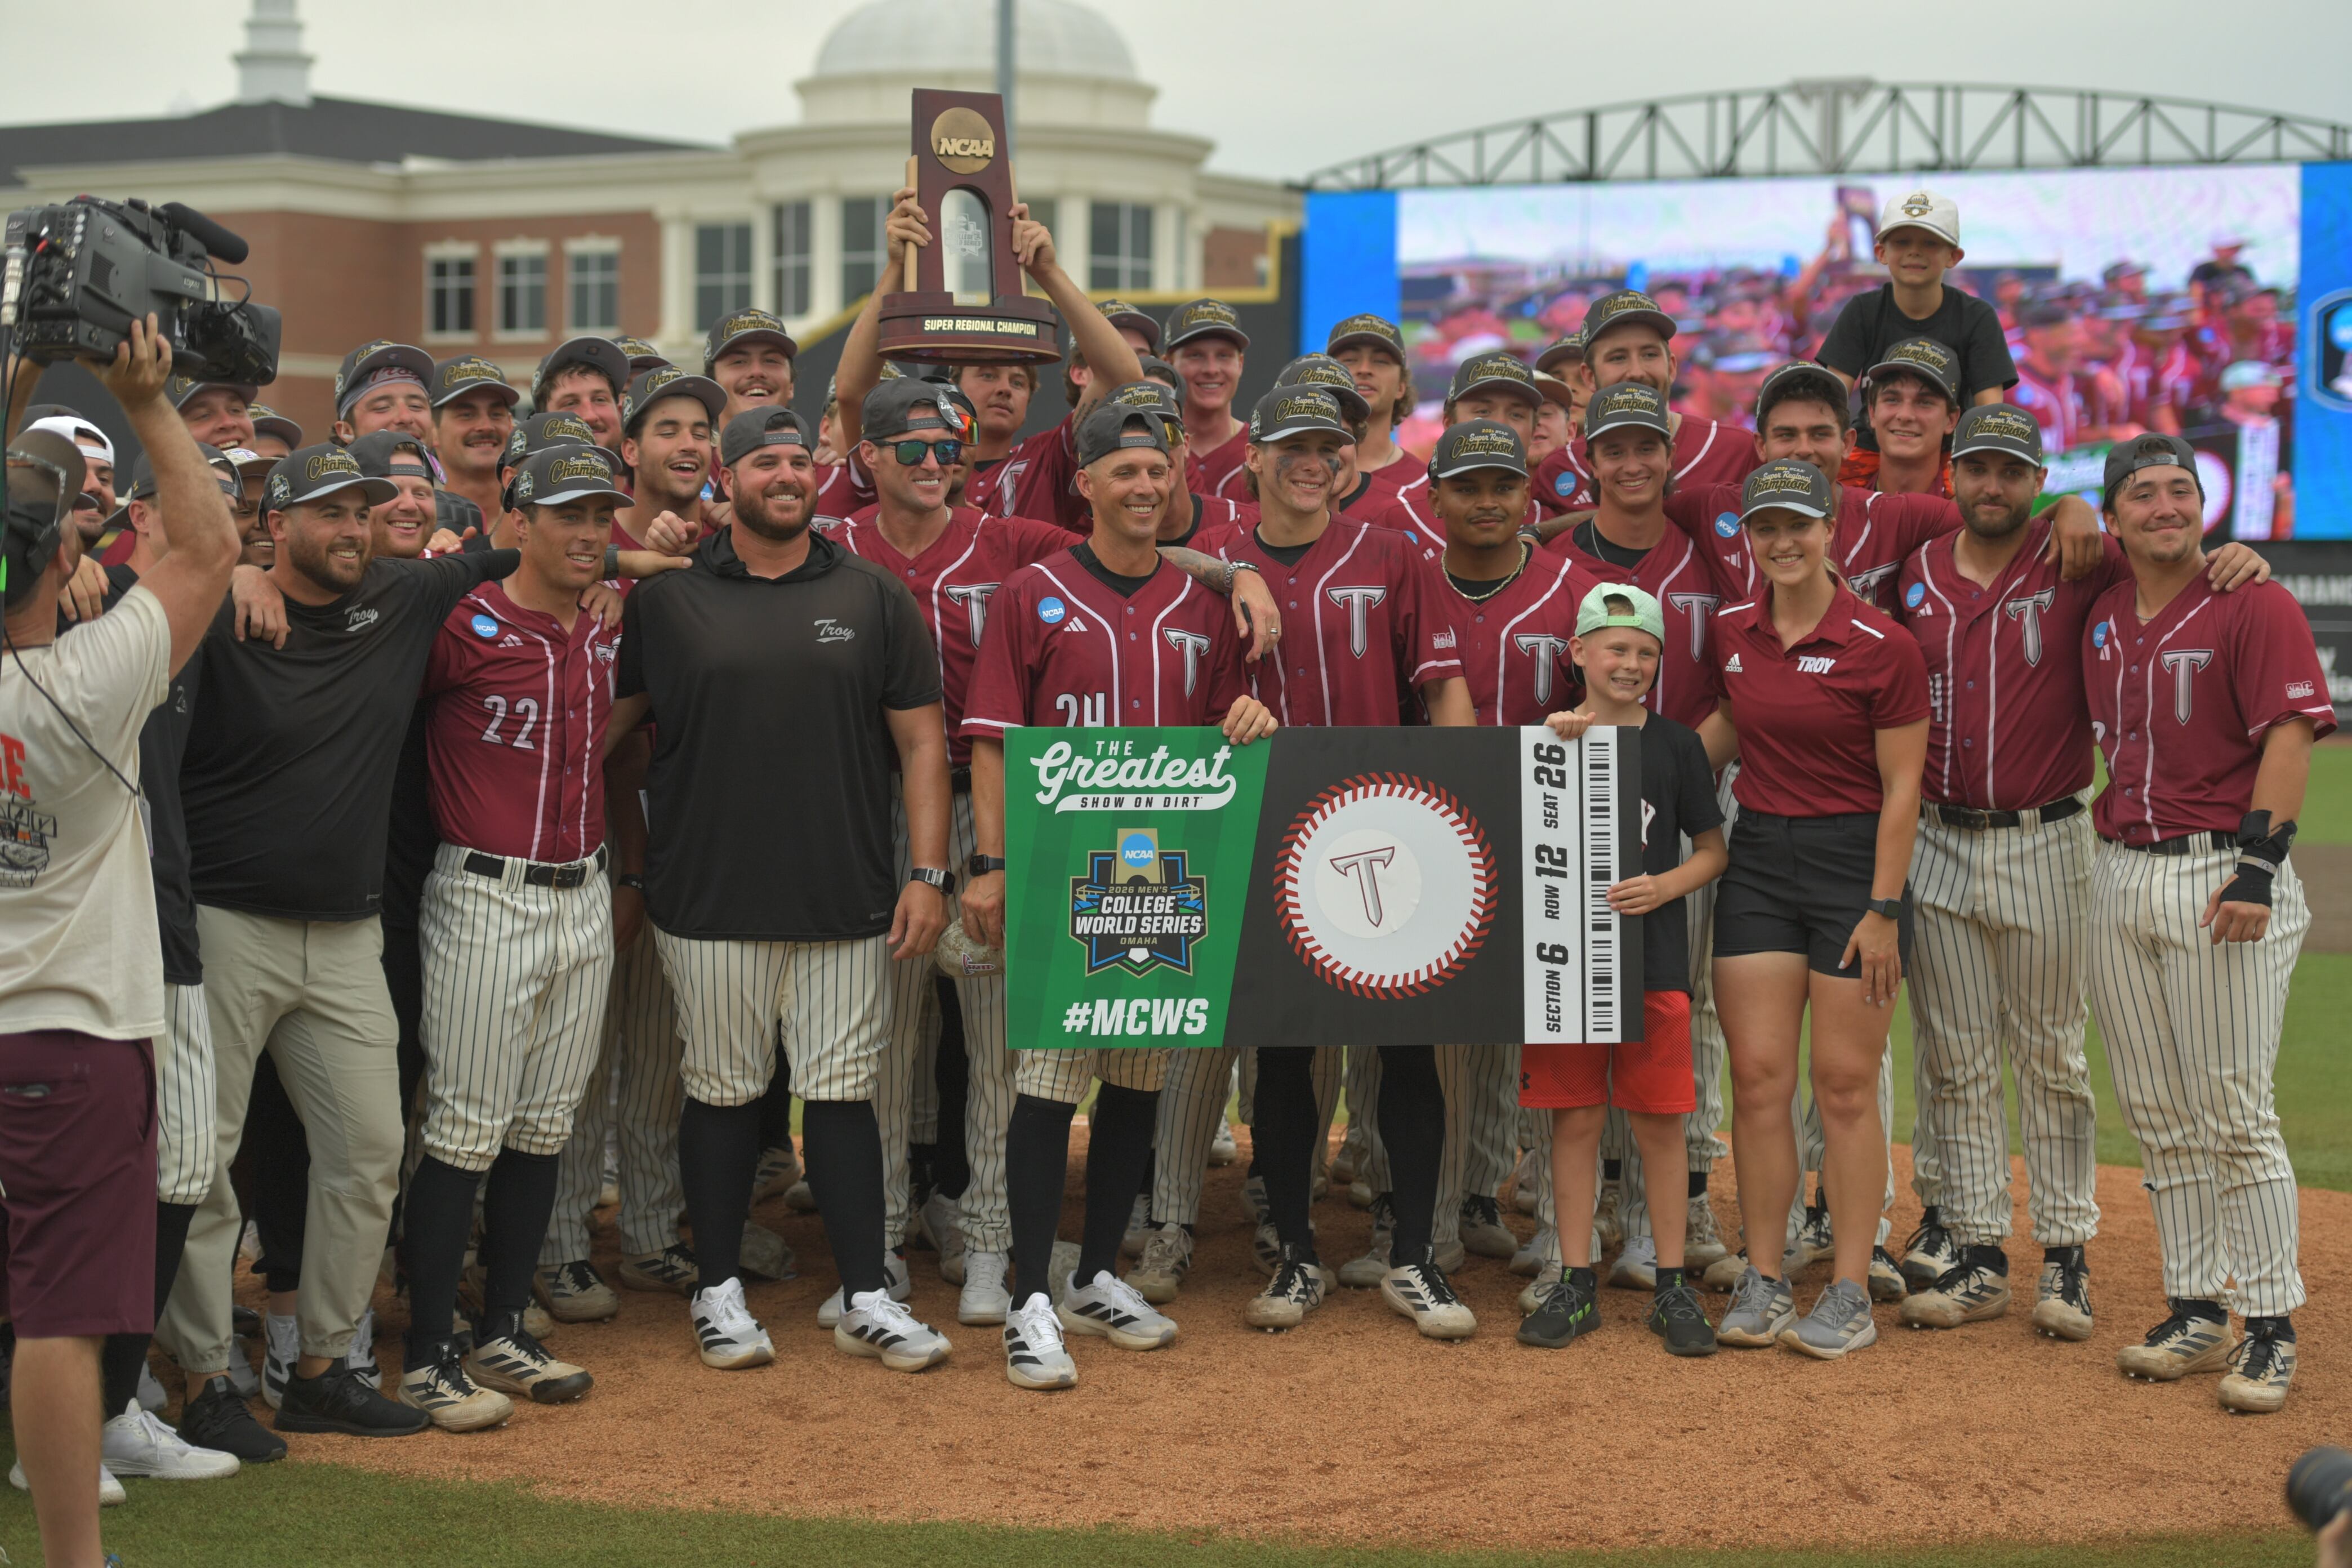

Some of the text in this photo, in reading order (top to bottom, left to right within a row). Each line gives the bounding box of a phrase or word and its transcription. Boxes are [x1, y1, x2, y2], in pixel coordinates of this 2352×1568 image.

[938, 138, 994, 158] NCAA
[924, 319, 1036, 336] SUPER REGIONAL CHAMPION
[1905, 343, 1924, 352] Super
[1316, 367, 1334, 375] Super
[1486, 359, 1505, 368] Super
[1119, 394, 1161, 407] mpions
[1295, 396, 1315, 404] Super
[1614, 393, 1658, 405] Super Regional
[1965, 416, 2032, 441] Champions
[1985, 415, 2032, 430] Super Regional
[1450, 435, 1514, 460] Champions
[1469, 433, 1514, 445] Super Regional
[570, 457, 590, 465] Super
[1763, 471, 1812, 483] Super Regional
[1747, 476, 1812, 502] Champions
[1717, 519, 1735, 536] NCAA
[344, 603, 378, 625] Troy
[1042, 607, 1063, 618] NCAA
[814, 619, 855, 642] Troy
[1326, 586, 1387, 659] T
[1668, 593, 1720, 662] T
[2006, 586, 2055, 667] T
[1162, 627, 1211, 702] T
[1514, 634, 1569, 706] T
[1797, 656, 1836, 674] TROY
[2161, 649, 2214, 726] T
[2286, 680, 2314, 699] SBC
[1055, 692, 1106, 727] 24
[480, 694, 539, 750] 22
[1096, 741, 1133, 756] THE
[1030, 741, 1236, 805] Greatest
[1080, 796, 1199, 808] SHOW ON DIRT
[1125, 850, 1153, 859] NCAA
[1329, 846, 1395, 928] T
[1534, 742, 1569, 1032] SECTION 6 ROW 12 SEAT 26
[1101, 896, 1176, 914] COLLEGE
[1076, 916, 1202, 934] WORLD SERIES
[1063, 998, 1209, 1035] #MCWS
